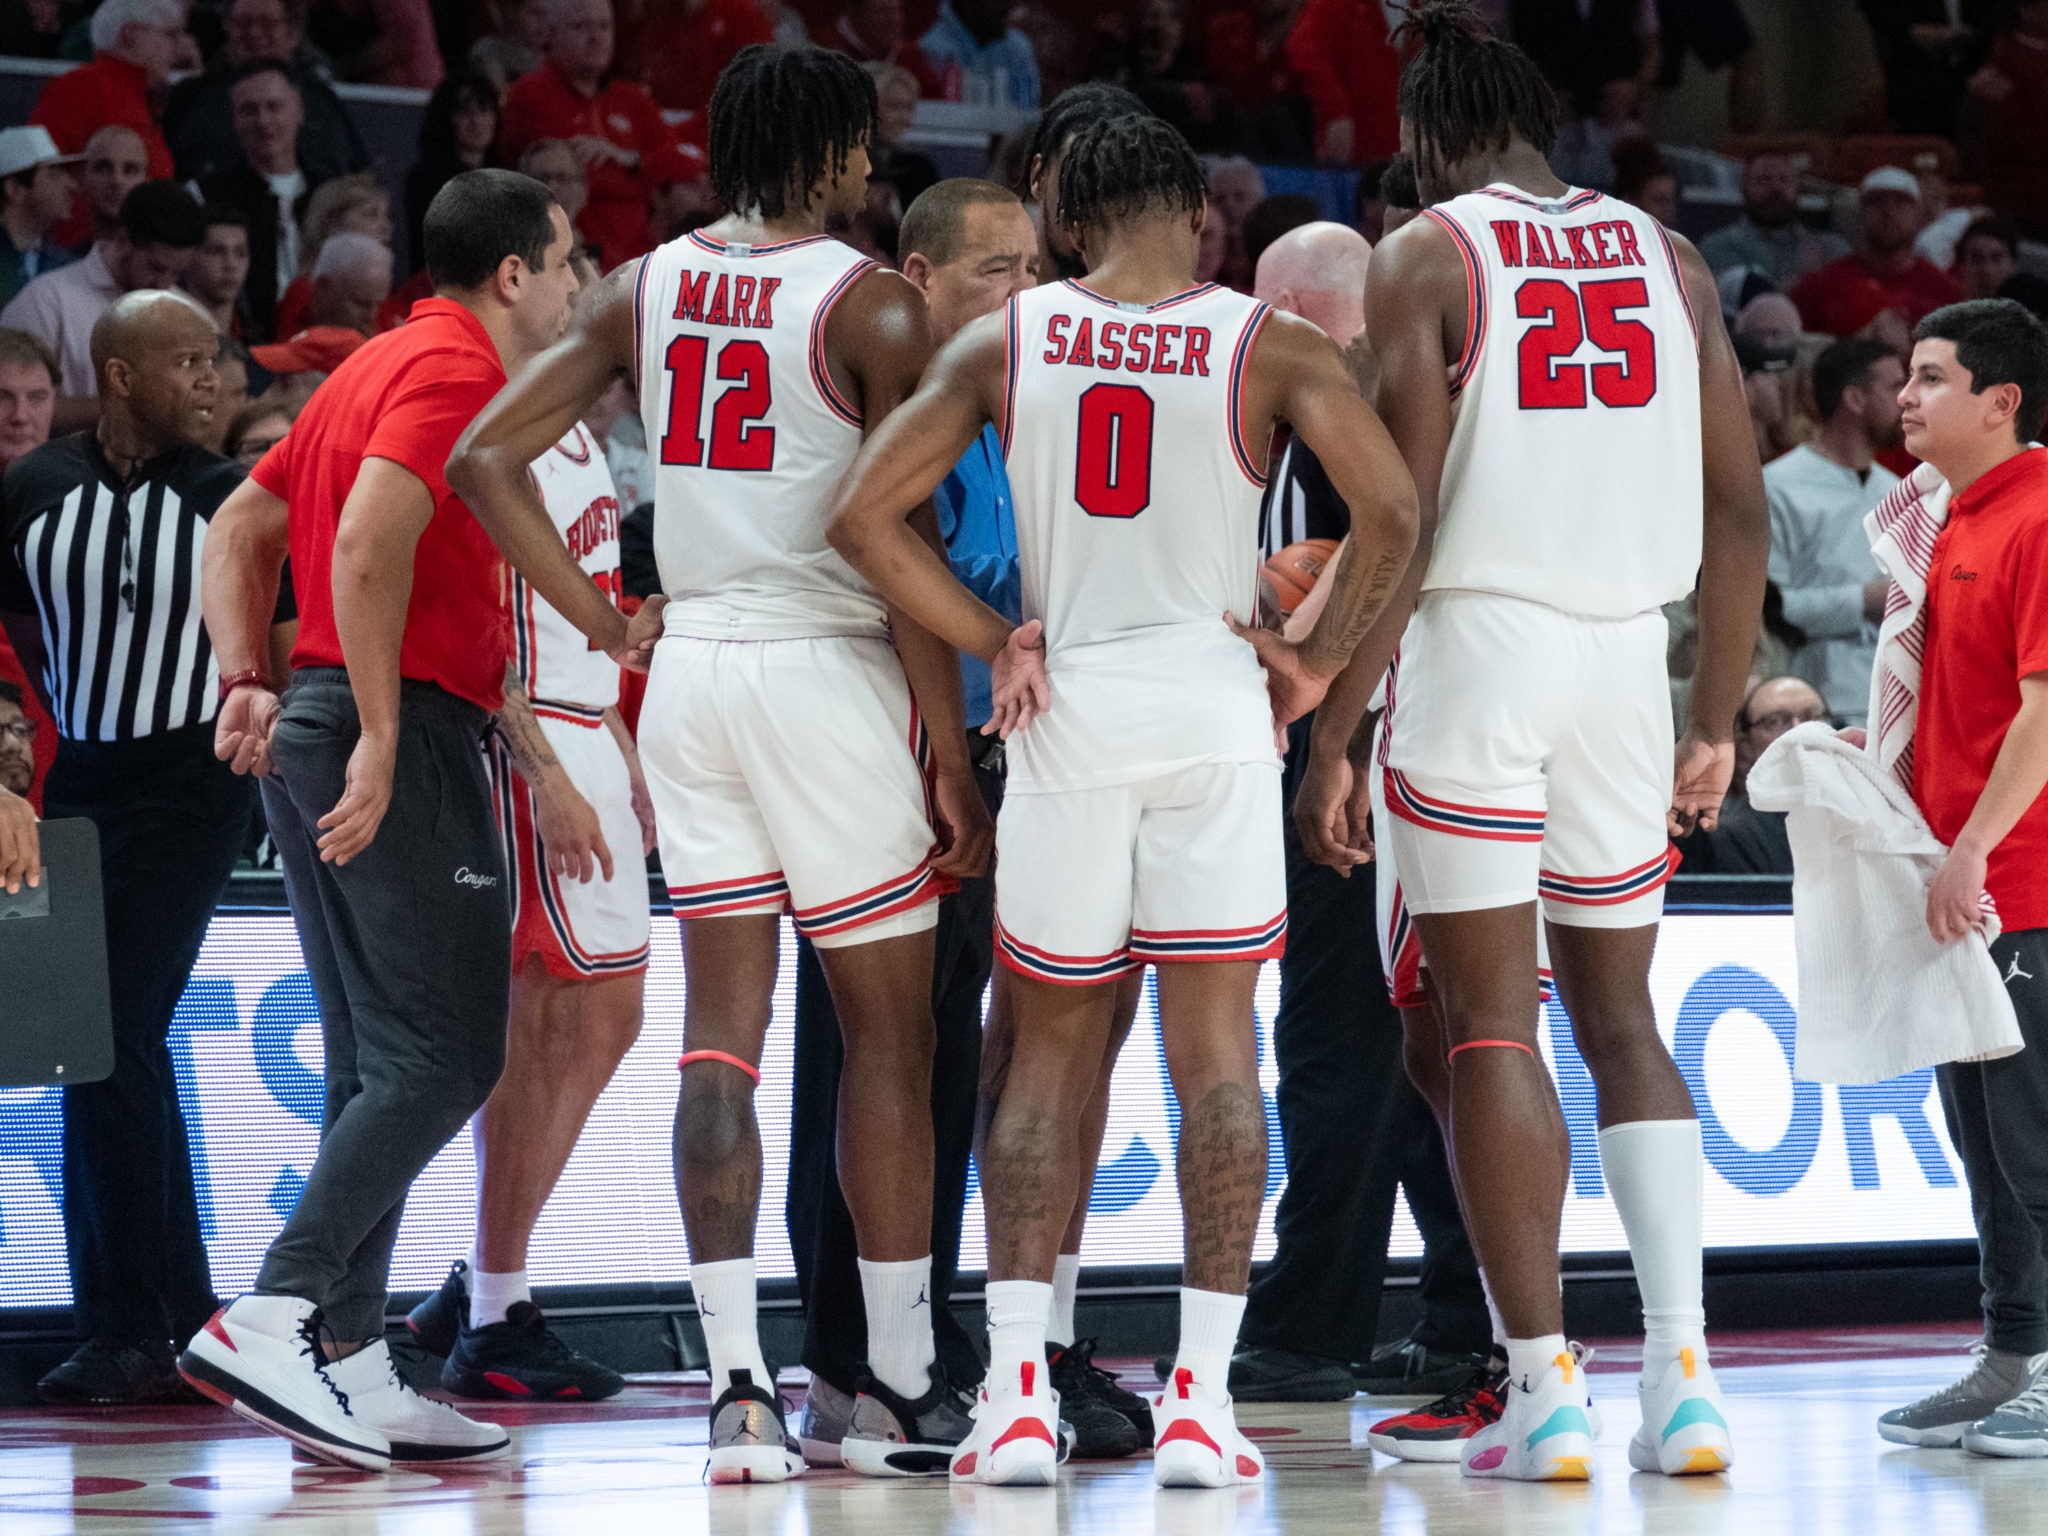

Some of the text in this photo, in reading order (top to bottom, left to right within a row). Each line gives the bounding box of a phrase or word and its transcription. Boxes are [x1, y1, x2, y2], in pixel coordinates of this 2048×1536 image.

[1490, 219, 1645, 269] WALKER
[673, 269, 781, 328] MARK
[1044, 314, 1211, 376] SASSER
[1515, 277, 1656, 410] 25
[661, 334, 775, 471] 12
[1075, 382, 1154, 519] 0
[455, 866, 497, 889] Cougars
